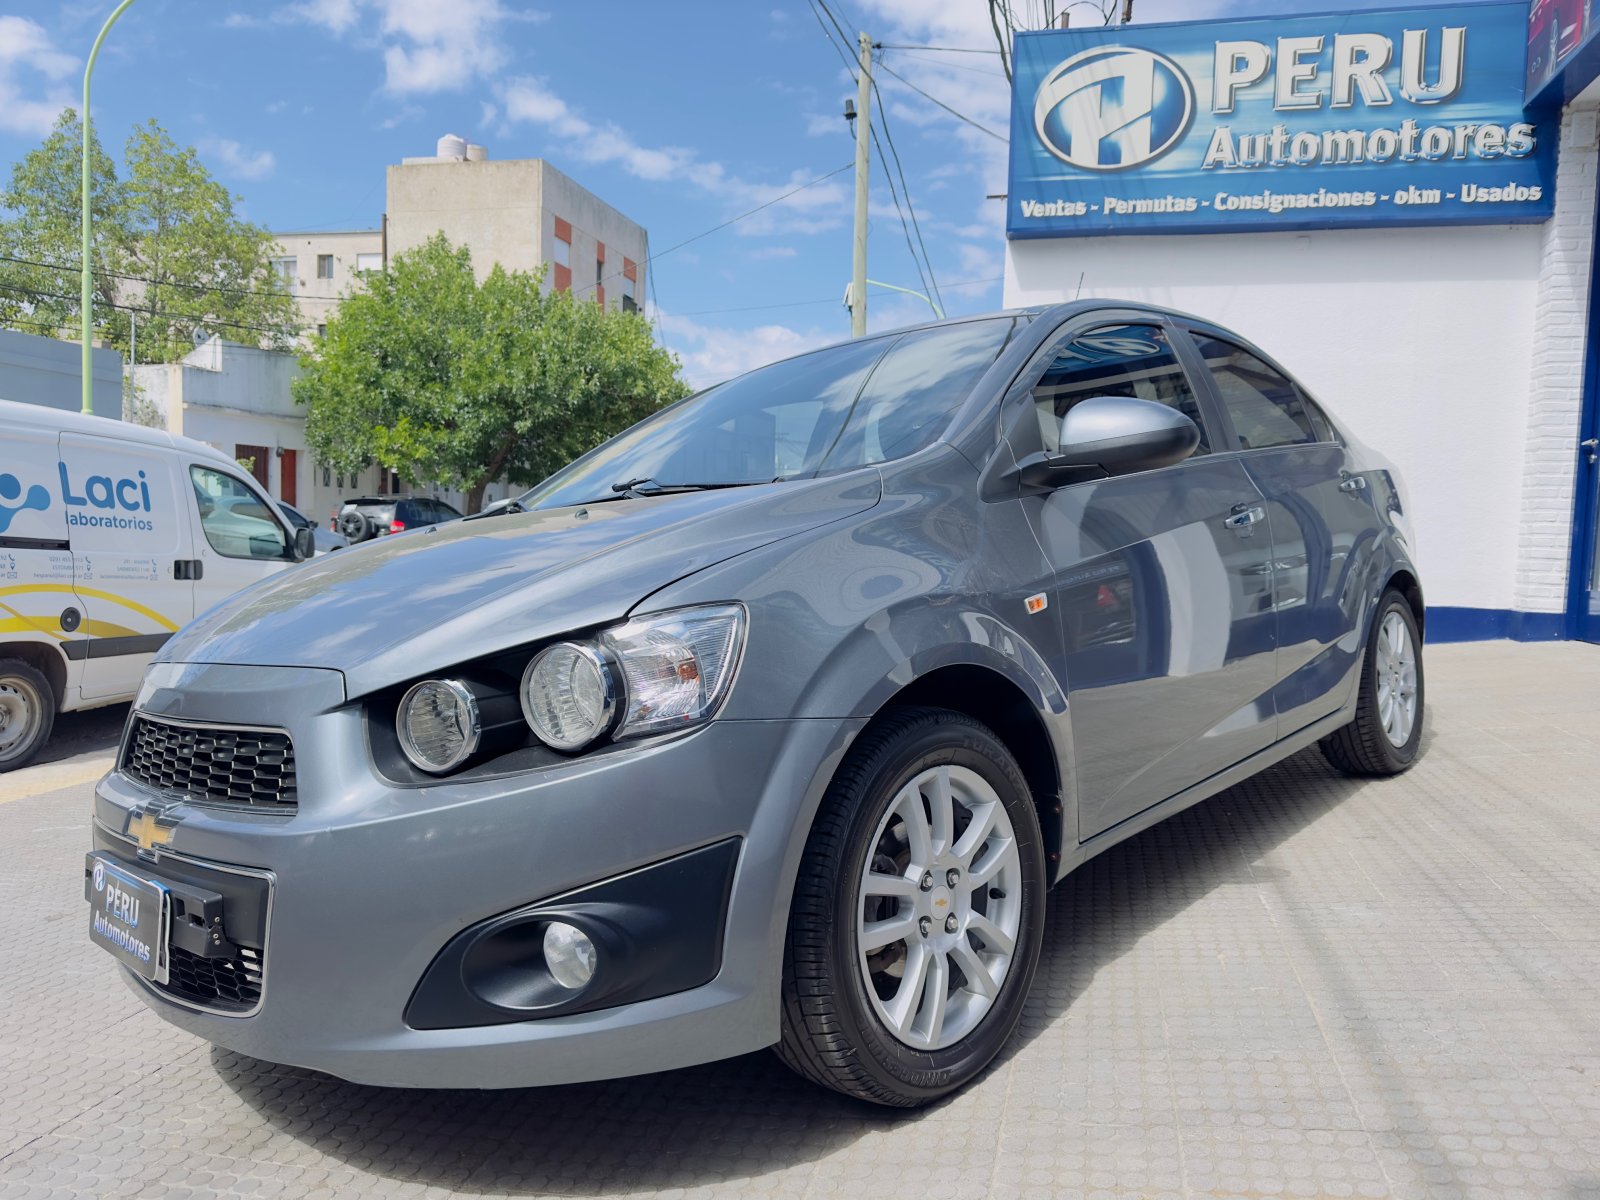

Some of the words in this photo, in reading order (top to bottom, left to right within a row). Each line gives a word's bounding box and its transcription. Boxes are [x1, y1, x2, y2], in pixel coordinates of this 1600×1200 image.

[1211, 26, 1466, 115] PERU
[1201, 119, 1538, 170] Automotores
[1020, 198, 1087, 218] Ventas
[1103, 195, 1198, 215] Permutas
[1213, 188, 1377, 214] Consignaciones
[1460, 182, 1543, 203] Usados
[58, 461, 151, 513] Laci
[65, 510, 153, 532] laboratorios
[105, 882, 140, 929] PERU
[94, 909, 151, 964] Automotores
